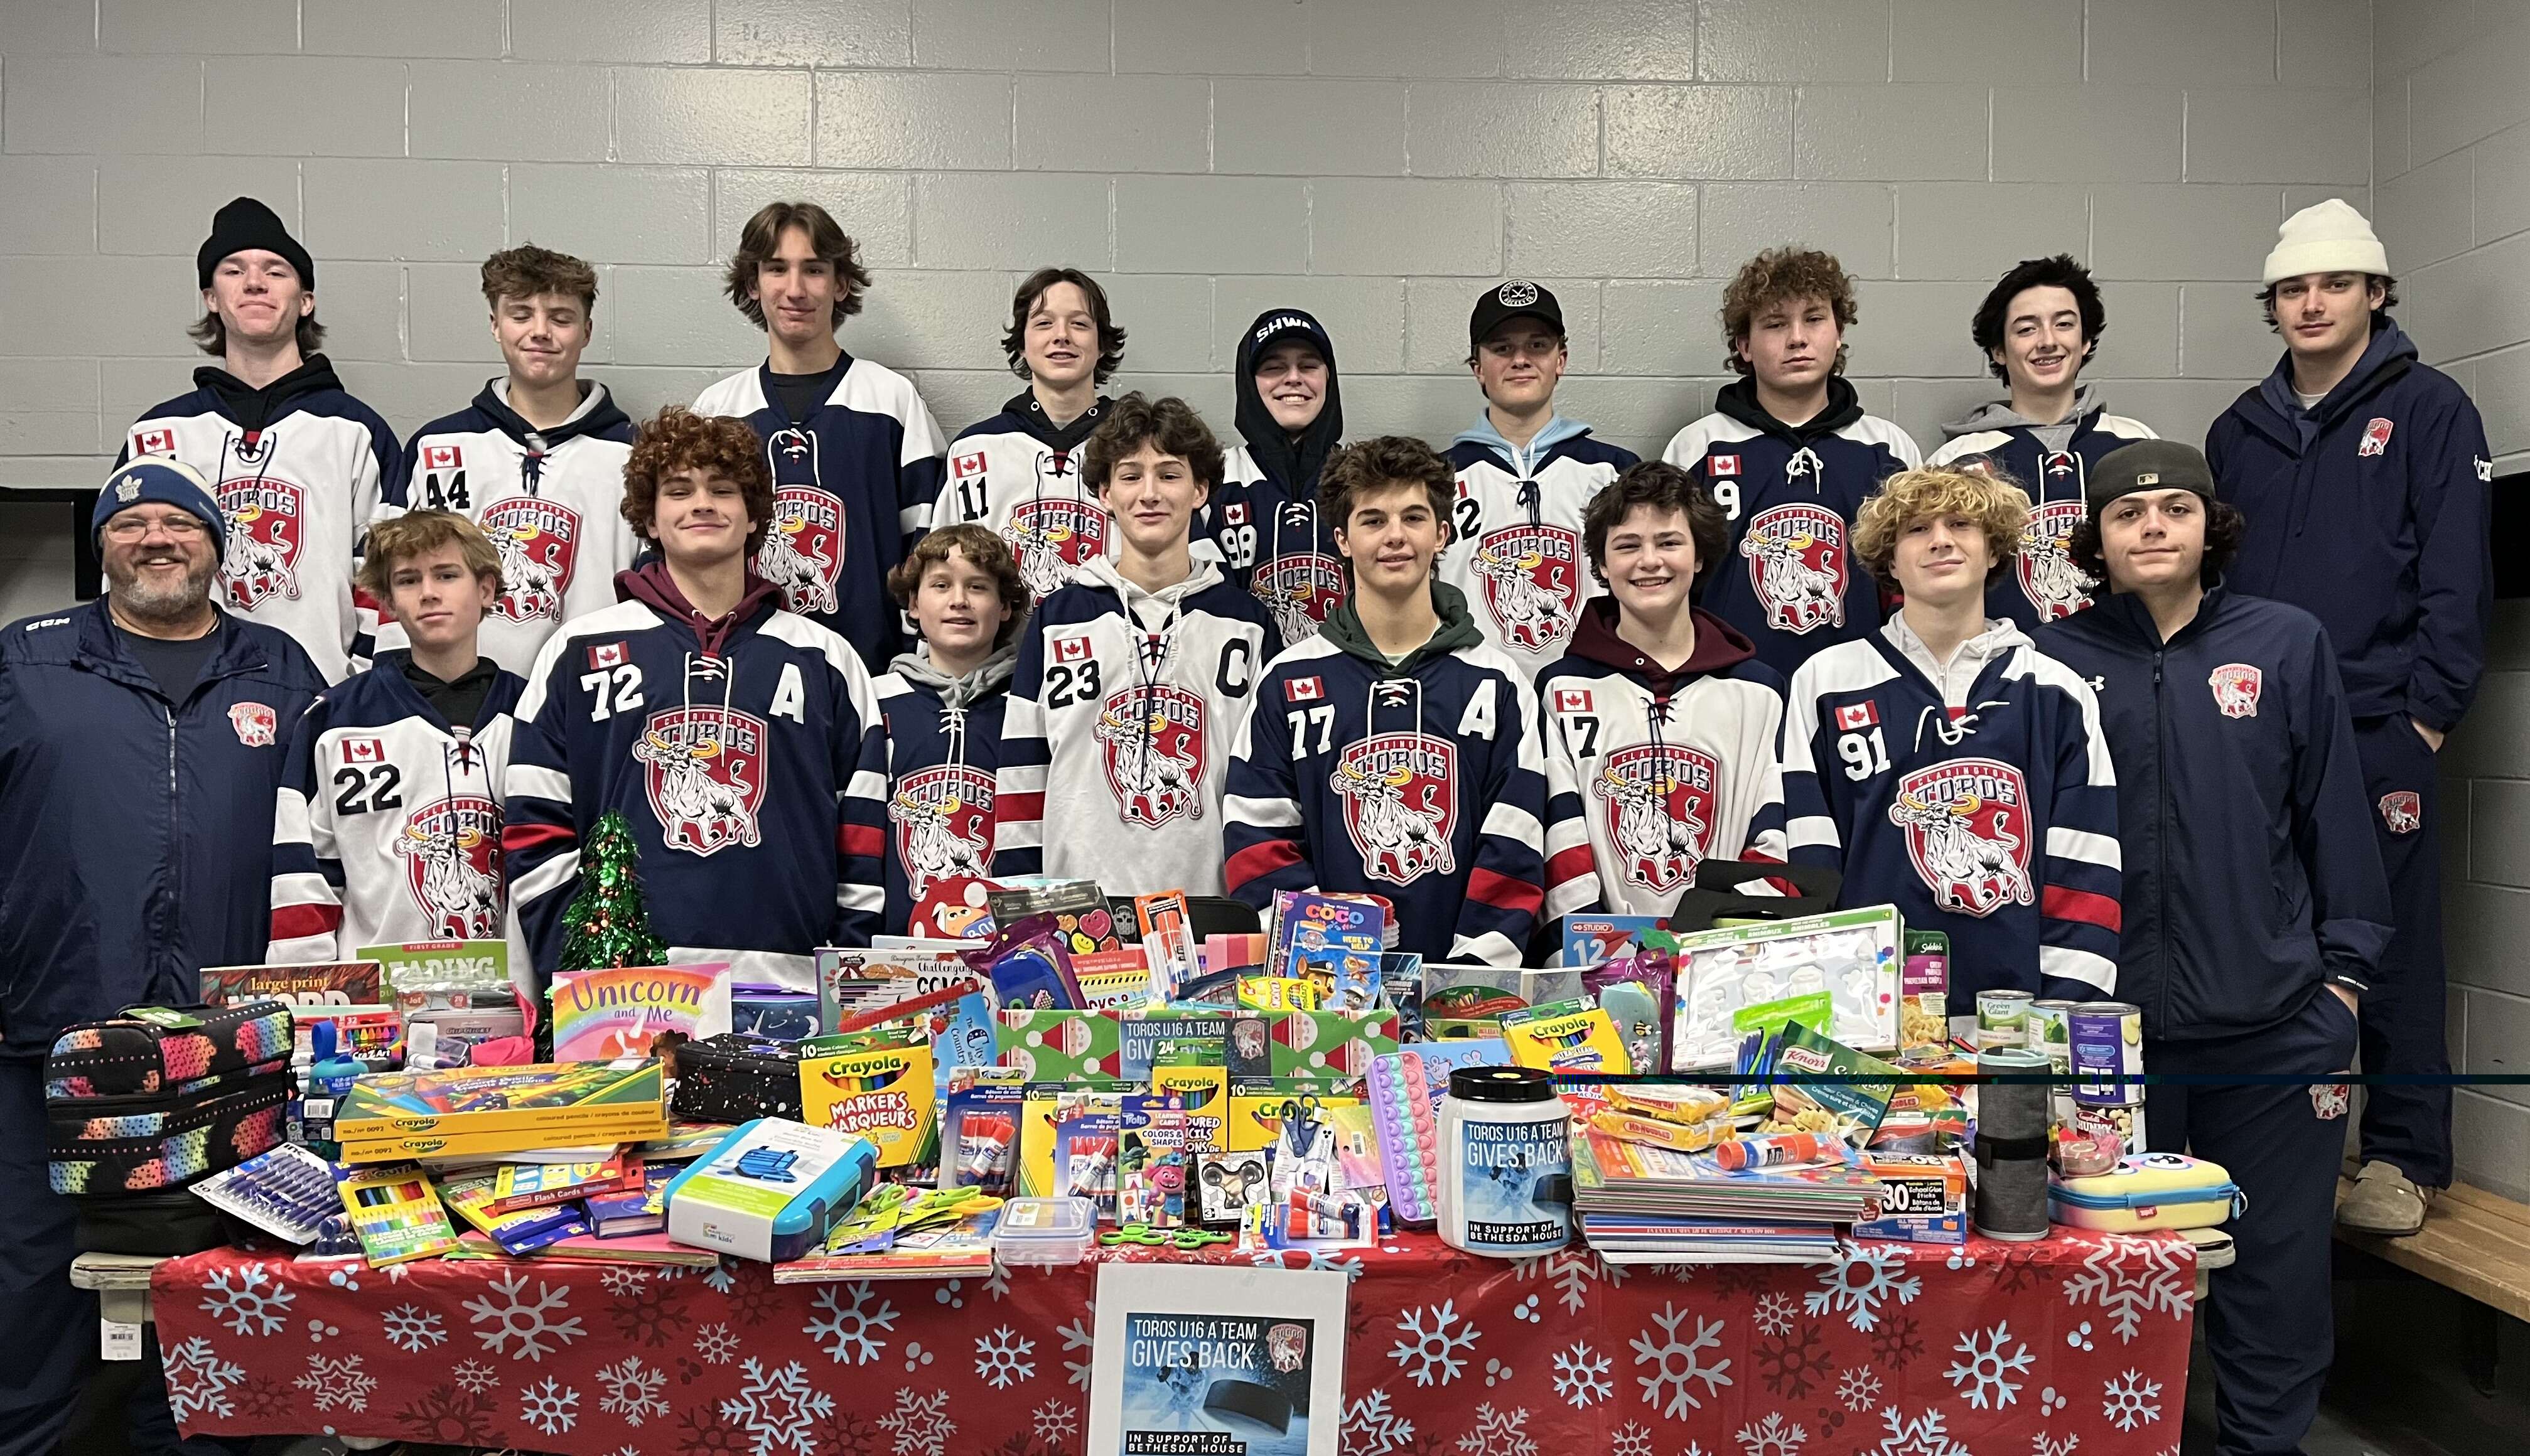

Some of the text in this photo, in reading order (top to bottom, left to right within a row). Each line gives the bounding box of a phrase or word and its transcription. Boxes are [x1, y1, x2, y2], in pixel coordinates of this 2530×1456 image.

[426, 470, 471, 511] 44
[957, 476, 989, 522] 11
[1713, 480, 1740, 521] 9
[492, 500, 568, 520] CLARINGTON
[778, 500, 836, 532] OROS
[488, 508, 572, 543] TOROS
[1021, 509, 1101, 542] TOROS
[1760, 516, 1841, 550] TOROS
[1219, 525, 1257, 569] 98
[1494, 528, 1567, 545] CLARINGTON
[1490, 535, 1572, 564] TOROS
[1216, 638, 1249, 698] C
[579, 663, 645, 723] 72
[768, 662, 805, 724] A
[1046, 659, 1102, 709] 23
[1112, 697, 1199, 732] TOROS
[1457, 678, 1497, 741] A
[658, 721, 757, 756] TOROS
[1287, 704, 1336, 761] 77
[1836, 726, 1892, 782] 91
[1352, 749, 1447, 781] TOROS
[1617, 756, 1712, 793] TOROS
[1917, 766, 2013, 787] CLARINGTON
[334, 763, 402, 816] 22
[908, 778, 994, 814] TOROS
[1912, 775, 2019, 807] TOROS
[1306, 904, 1364, 924] COCO
[1583, 924, 1610, 933] STUDIO
[409, 943, 429, 951] FIRST
[1573, 938, 1606, 966] 12
[250, 975, 330, 993] large print
[570, 977, 702, 1012] Unicorn
[615, 1005, 674, 1023] and Me
[1987, 1002, 2010, 1010] Green
[1988, 1008, 2010, 1016] Giant
[346, 1016, 358, 1025] 32
[1127, 1022, 1161, 1037] TOROS
[1163, 1022, 1183, 1036] U16
[1185, 1022, 1193, 1036] A
[1195, 1020, 1225, 1036] TEAM
[1533, 1018, 1589, 1037] Crayola
[800, 1044, 817, 1059] 10
[950, 1027, 966, 1065] Country
[1126, 1038, 1154, 1061] GIV
[1158, 1039, 1176, 1055] 24
[829, 1056, 901, 1076] Crayola
[1786, 1050, 1826, 1068] Knorr
[1165, 1077, 1214, 1089] Crayola
[1231, 1084, 1247, 1097] 10
[1738, 1084, 1758, 1099] 15
[830, 1091, 908, 1120] MARKERS
[1025, 1089, 1040, 1101] 10
[395, 1117, 435, 1131] Crayola
[1122, 1112, 1147, 1126] Trolls
[1185, 1116, 1221, 1129] OURED
[1151, 1138, 1183, 1146] SHAPES
[1176, 1130, 1183, 1138] &
[1467, 1121, 1564, 1142] TOROS U16 A TEAM
[402, 1138, 443, 1152] Crayola
[1467, 1138, 1564, 1169] GIVES BACK
[534, 1194, 556, 1202] Flash
[557, 1187, 581, 1198] Cards
[1883, 1184, 1909, 1211] 30
[1470, 1223, 1553, 1235] IN SUPPORT OF
[1470, 1229, 1562, 1243] BETHESDA HOUSE
[1134, 1319, 1257, 1341] TOROS U16 A TEAM
[1131, 1339, 1256, 1370] GIVES BACK
[1128, 1433, 1229, 1445] IN SUPPORT OF
[1128, 1442, 1244, 1454] BETHESDA HOUSE
